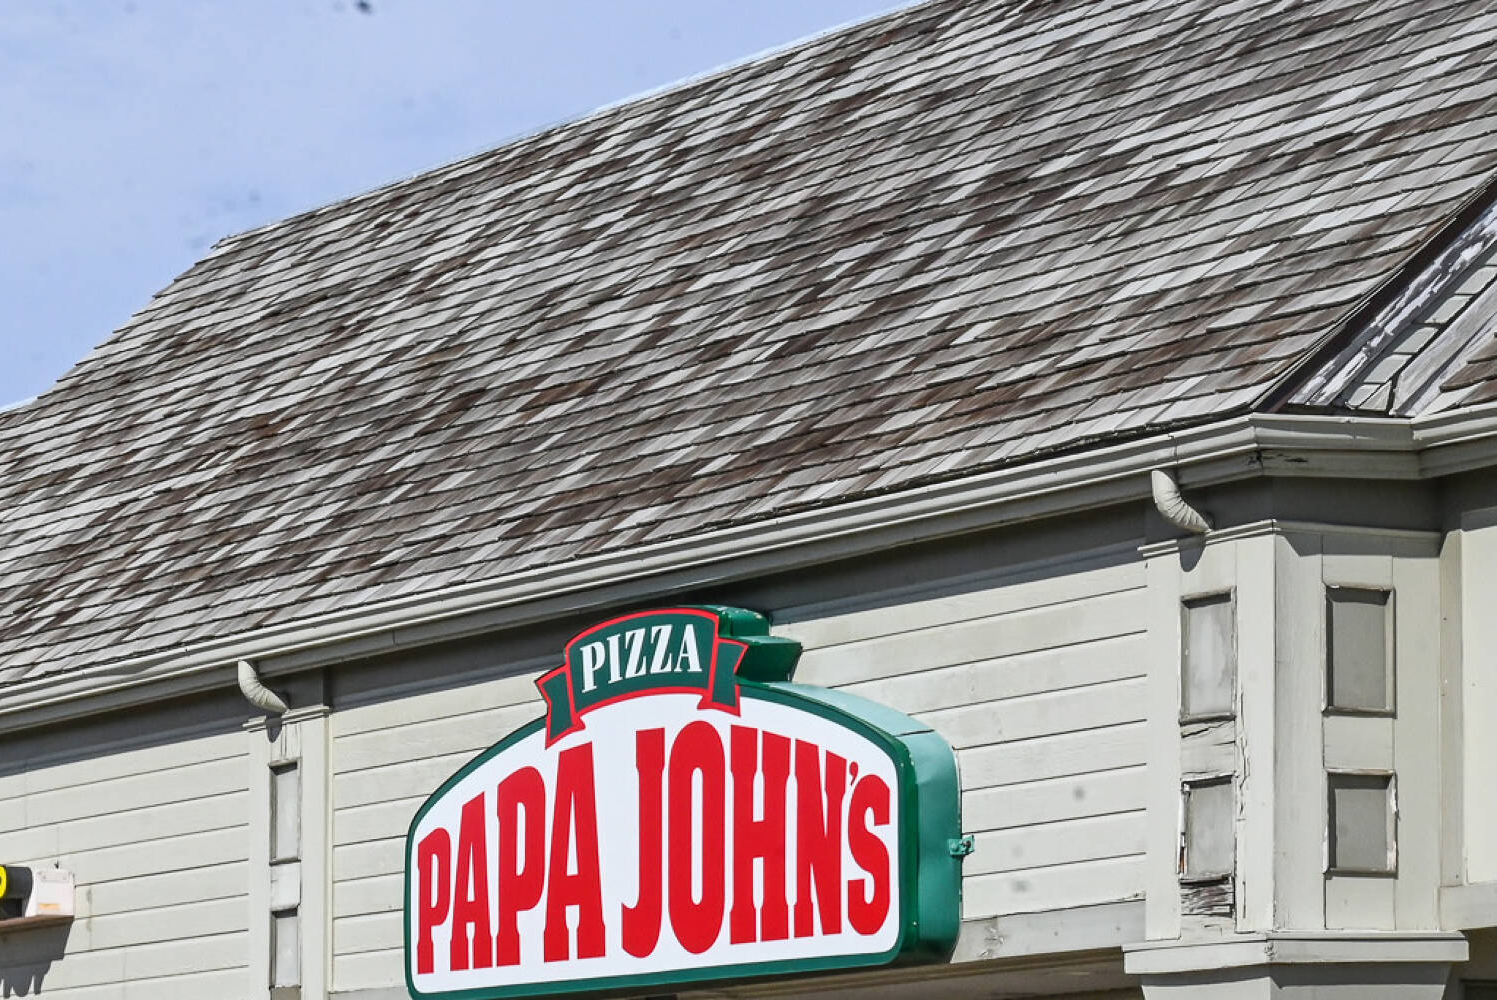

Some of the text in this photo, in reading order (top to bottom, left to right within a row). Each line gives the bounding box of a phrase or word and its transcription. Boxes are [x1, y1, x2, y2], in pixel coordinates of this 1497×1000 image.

[580, 623, 704, 694] PIZZA
[416, 720, 891, 976] PAPA JOHN'S
